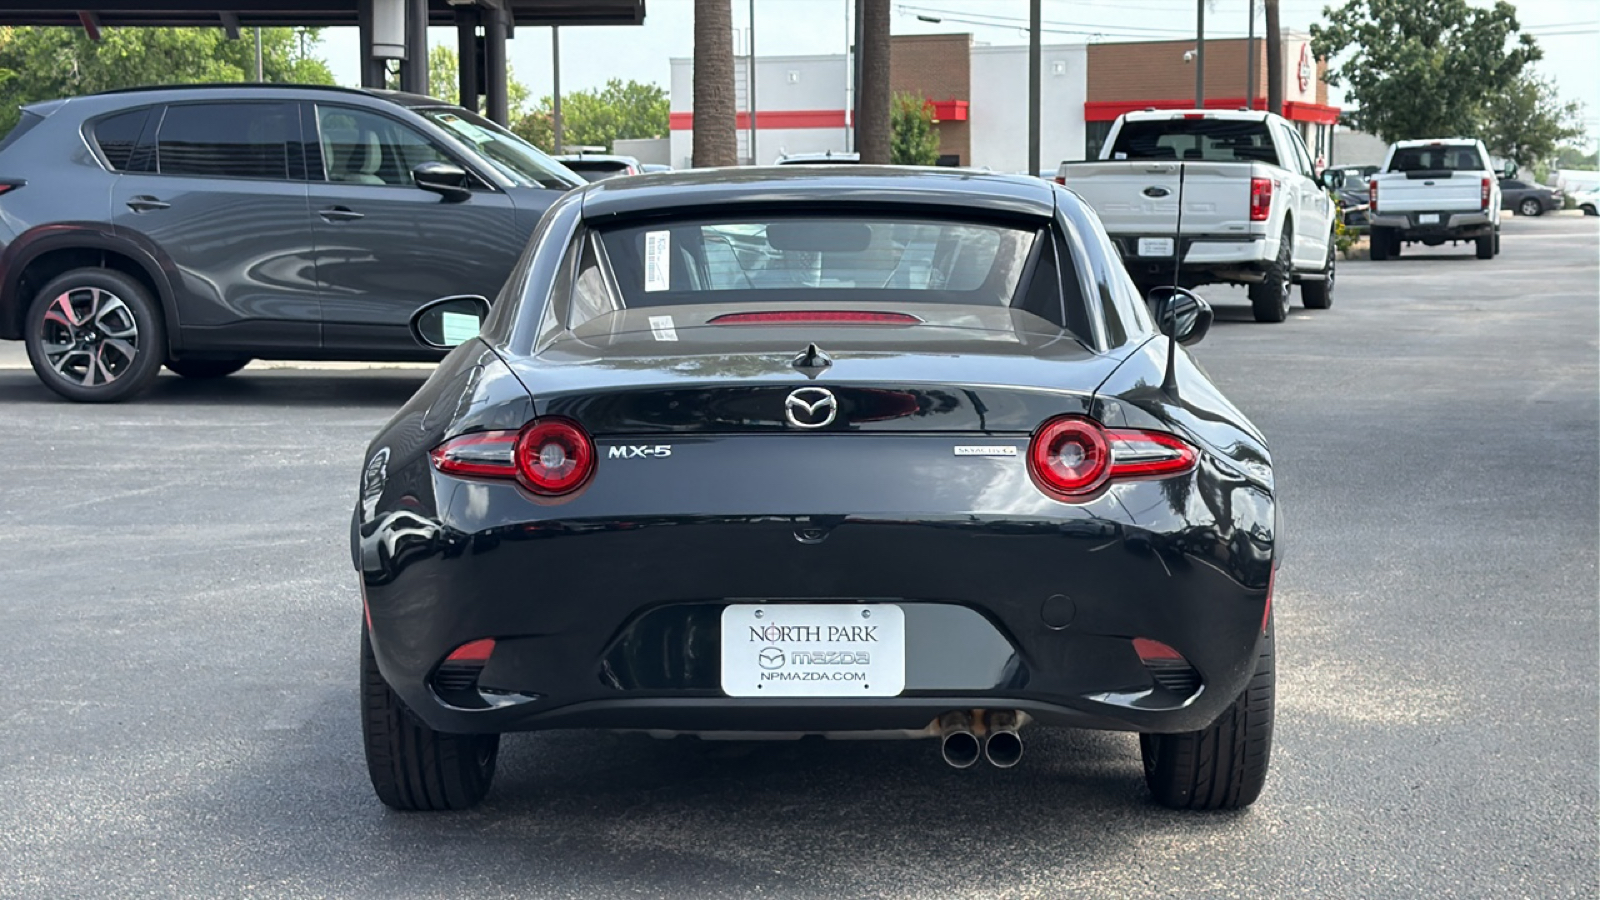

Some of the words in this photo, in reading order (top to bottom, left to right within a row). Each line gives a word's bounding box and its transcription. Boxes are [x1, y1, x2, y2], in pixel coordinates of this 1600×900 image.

[608, 444, 672, 459] MX-5
[749, 625, 820, 642] NORTH
[828, 625, 879, 642] PARK
[791, 651, 870, 665] mazda
[760, 672, 866, 681] NPMAZDA.COM
